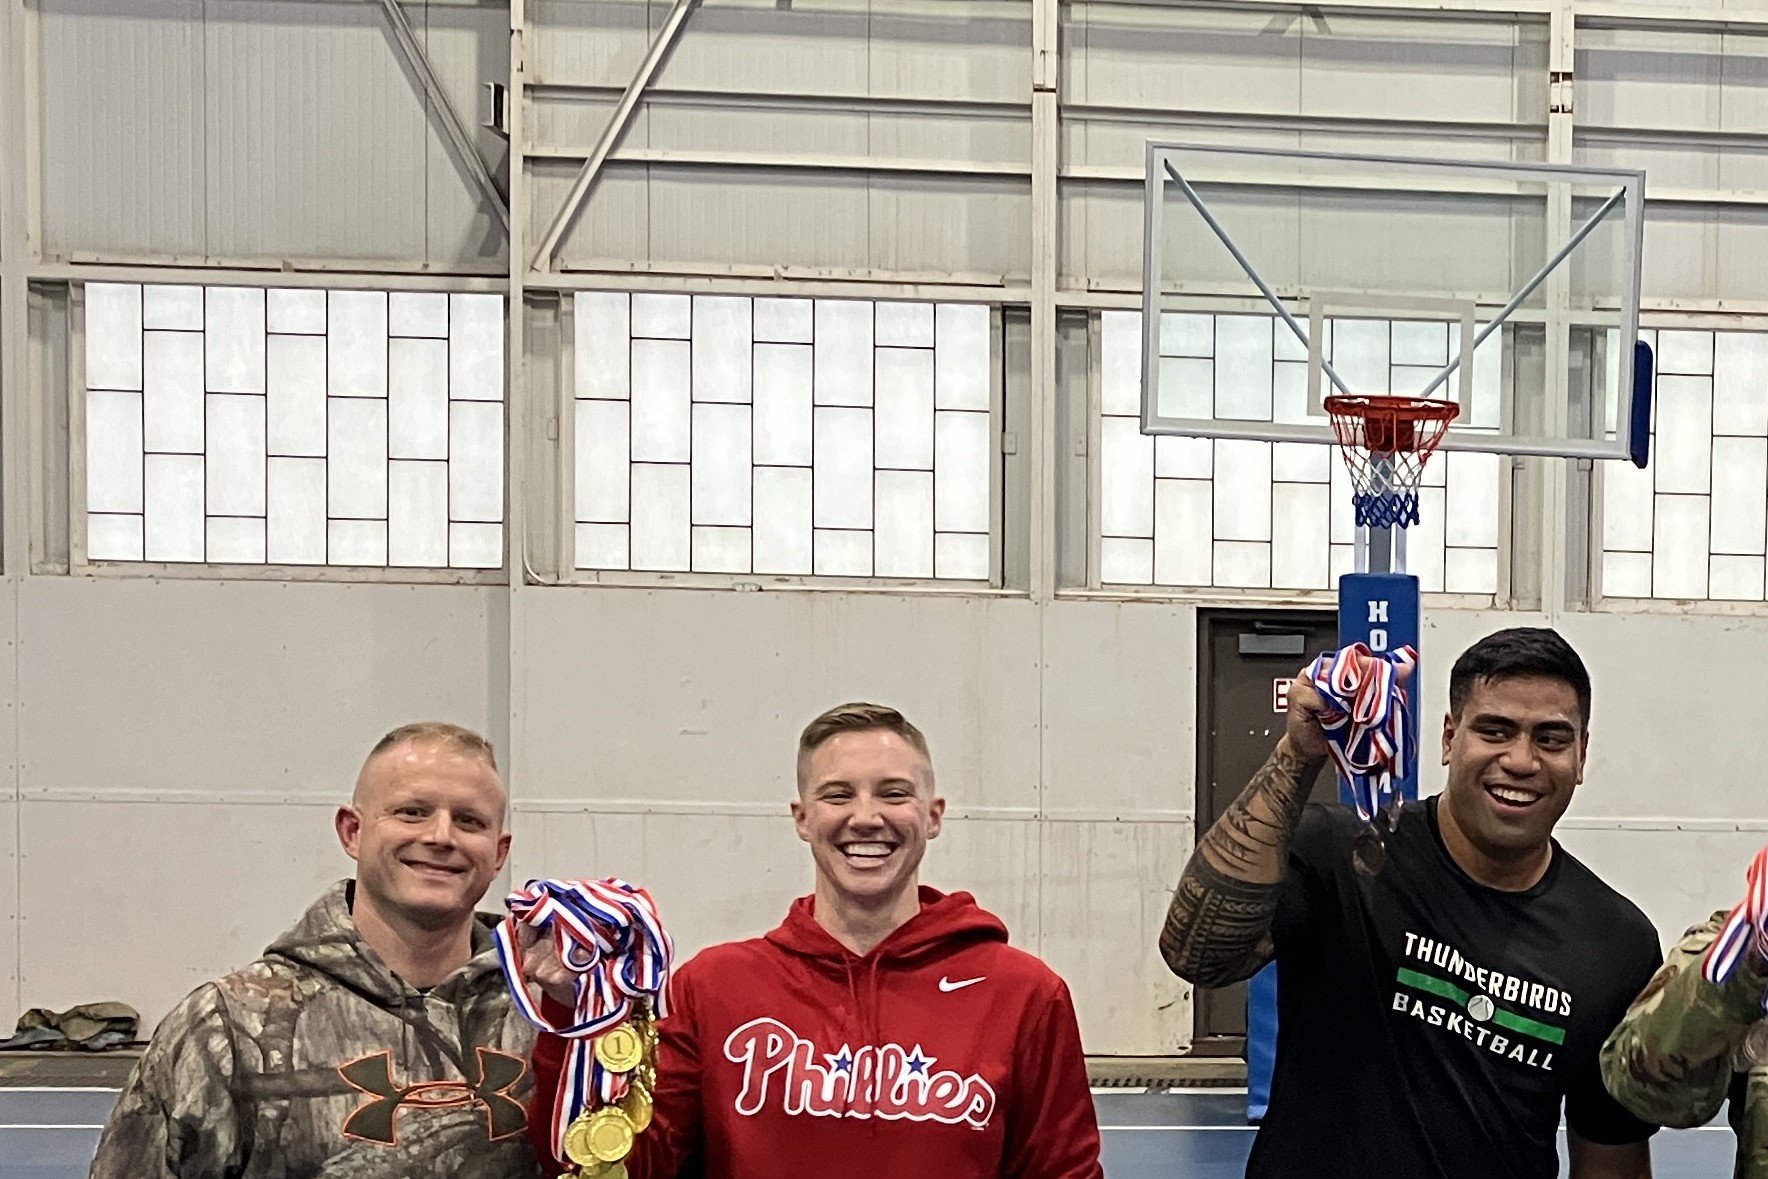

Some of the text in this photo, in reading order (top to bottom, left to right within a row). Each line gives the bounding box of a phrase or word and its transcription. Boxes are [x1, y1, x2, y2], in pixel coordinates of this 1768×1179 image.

[1403, 931, 1572, 1017] THUNDERBIRDS
[612, 1036, 624, 1054] 1
[723, 1016, 996, 1127] Phillies
[1392, 991, 1554, 1071] BASKETBALL
